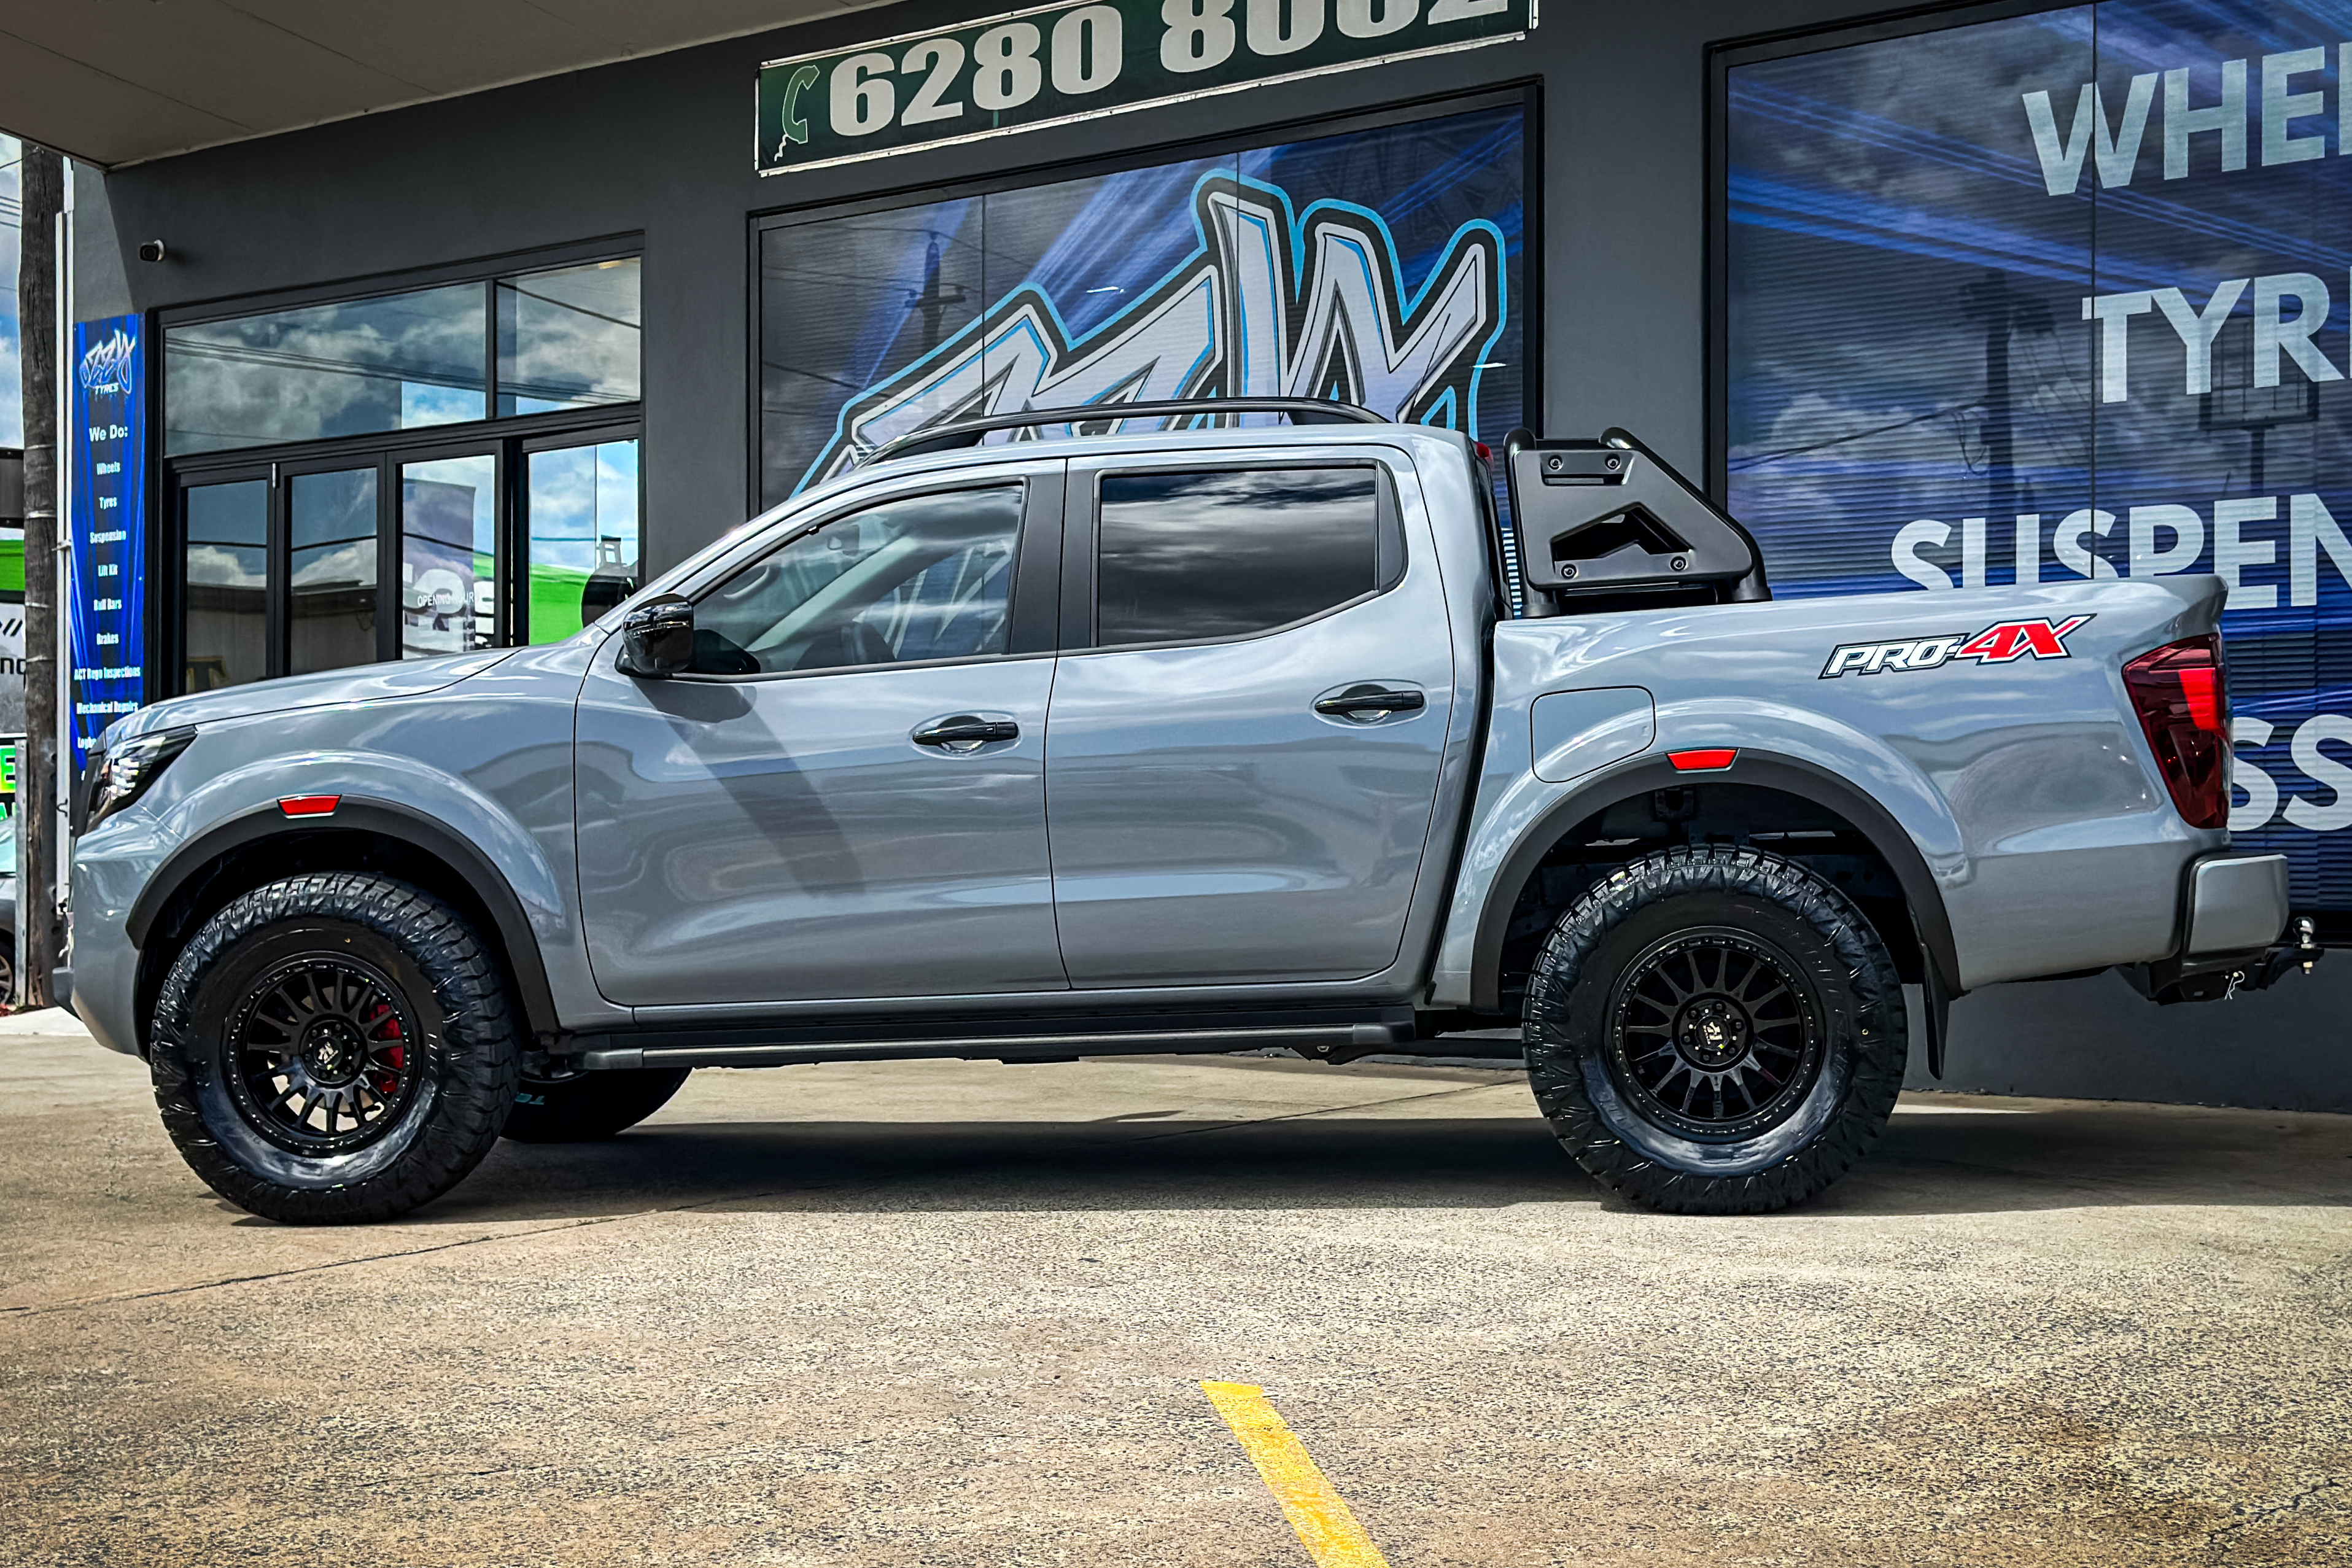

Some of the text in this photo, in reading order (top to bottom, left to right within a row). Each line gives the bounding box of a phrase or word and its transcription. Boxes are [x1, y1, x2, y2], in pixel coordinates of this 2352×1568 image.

[829, 0, 1509, 138] 6280 80
[2022, 41, 2352, 196] WHE
[2082, 266, 2352, 403] TYR
[89, 424, 128, 442] We Do:
[96, 461, 121, 475] Wheels
[99, 497, 117, 510] Tyres
[90, 529, 126, 544] Suspension
[98, 564, 118, 577] Lift Kit
[93, 598, 122, 611] Bull Bars
[96, 632, 119, 645] Brakes
[1818, 613, 2097, 679] PRO-4X
[74, 666, 141, 681] ACT Rego Inspections
[76, 701, 138, 715] Mechanical Repairs
